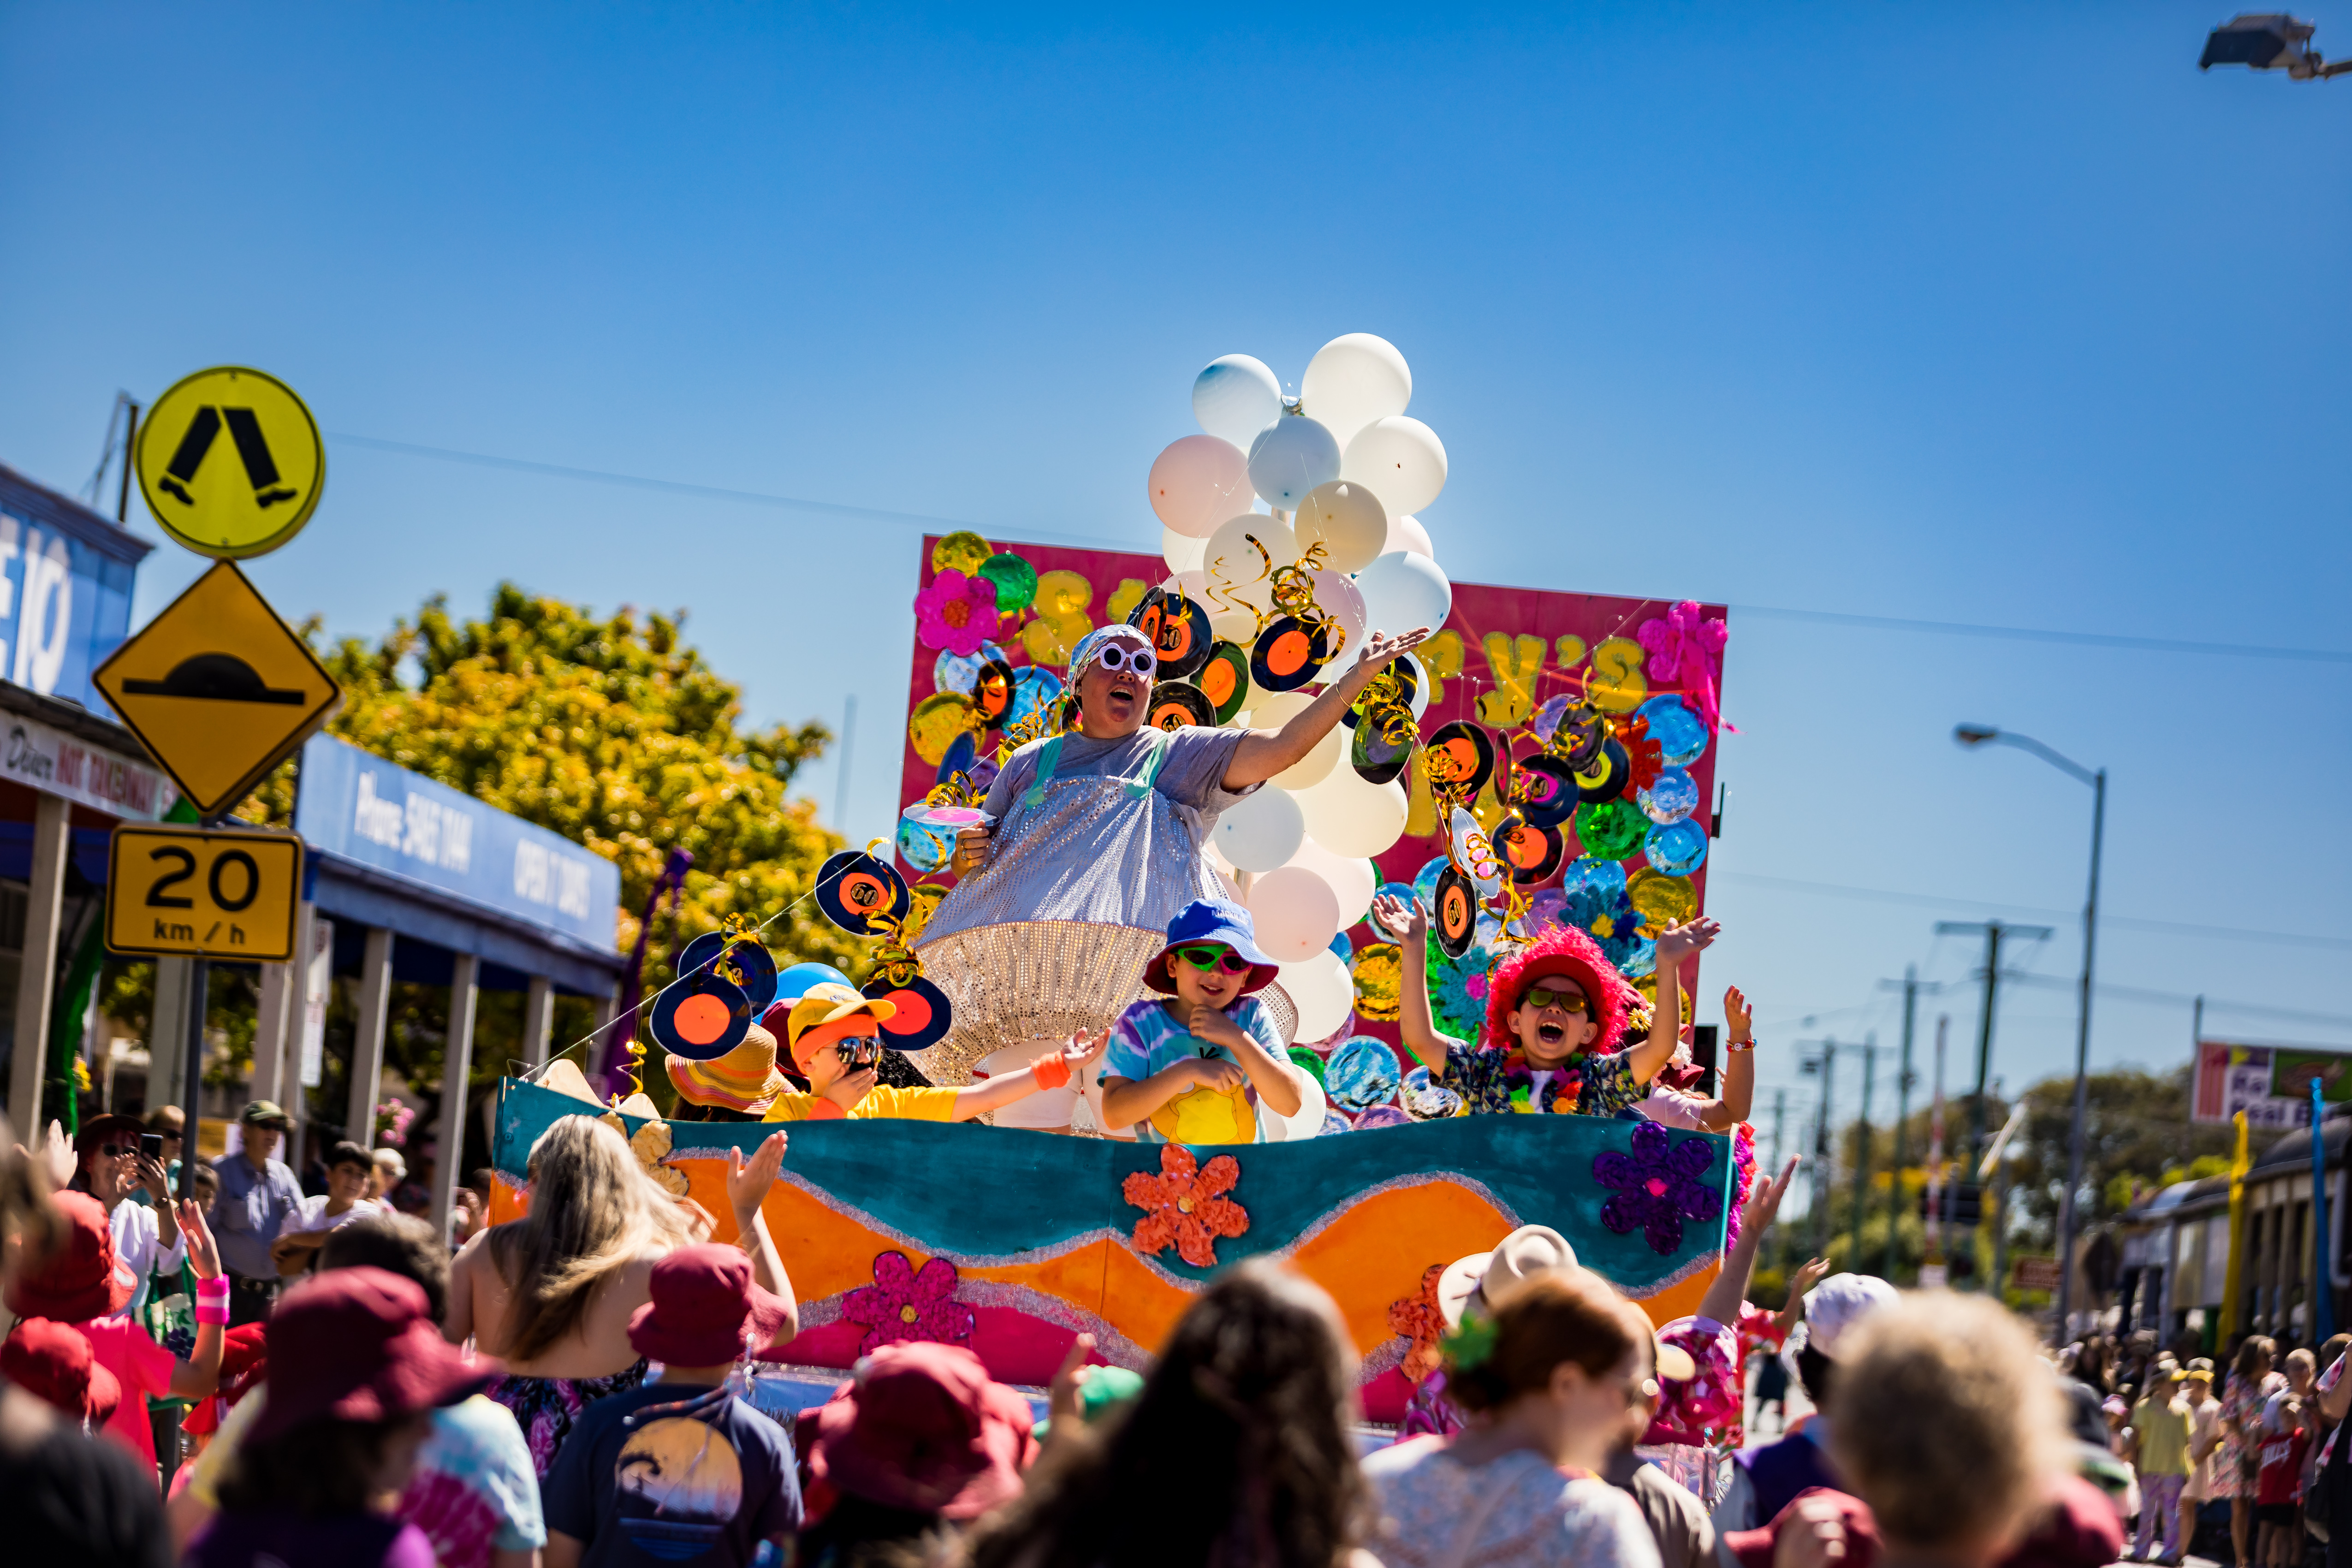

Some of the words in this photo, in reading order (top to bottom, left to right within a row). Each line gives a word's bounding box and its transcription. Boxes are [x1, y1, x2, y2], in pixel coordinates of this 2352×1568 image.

[145, 844, 261, 913] 20
[851, 883, 879, 906] 60
[1448, 899, 1461, 925] 60
